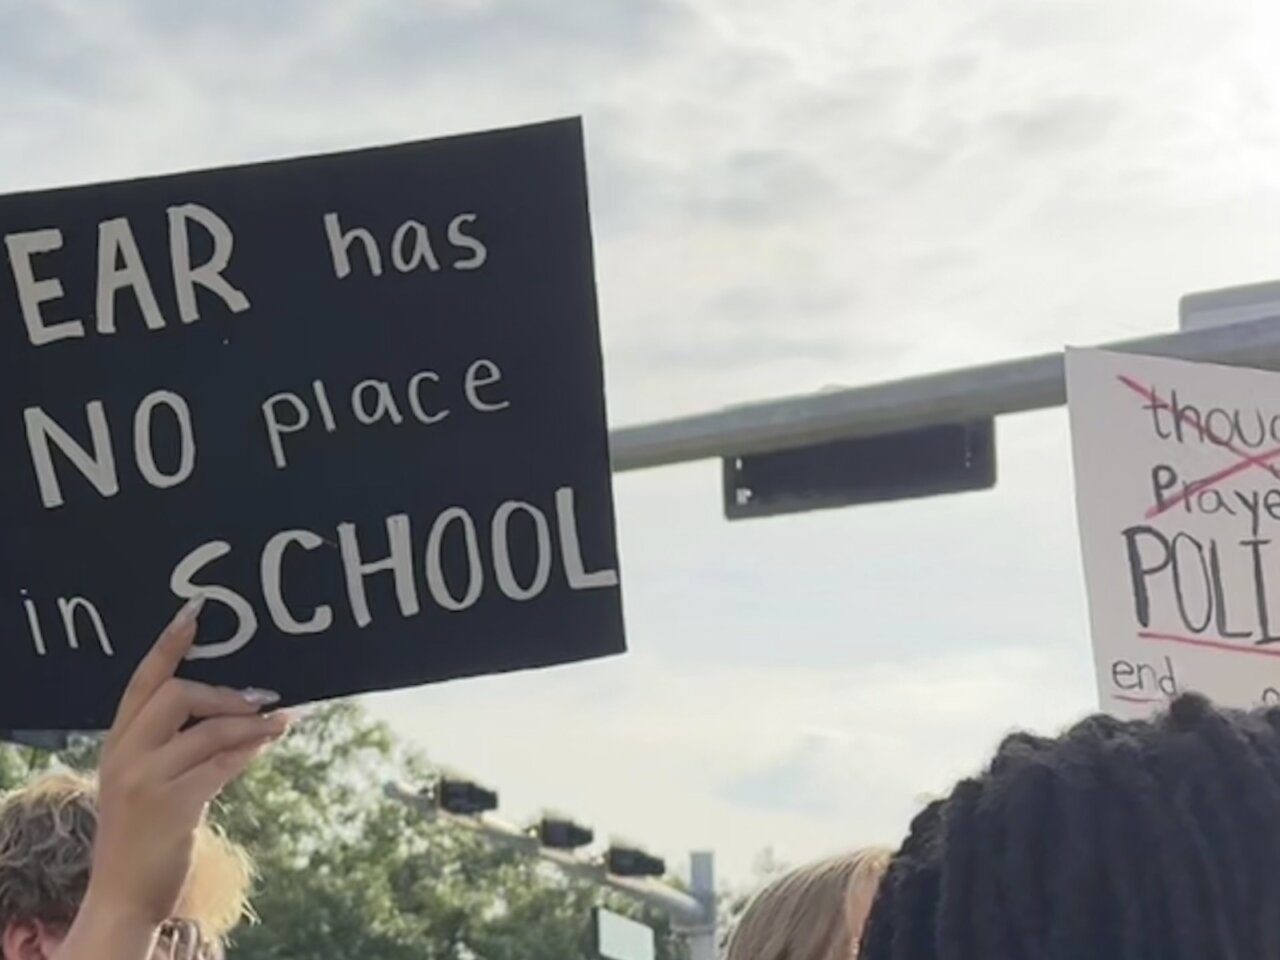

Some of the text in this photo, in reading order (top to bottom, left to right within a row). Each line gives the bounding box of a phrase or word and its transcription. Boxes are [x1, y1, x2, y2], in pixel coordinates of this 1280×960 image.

[322, 211, 488, 280] has
[22, 357, 511, 508] NO place
[19, 486, 618, 661] in SCHOOL
[1111, 656, 1177, 697] end
